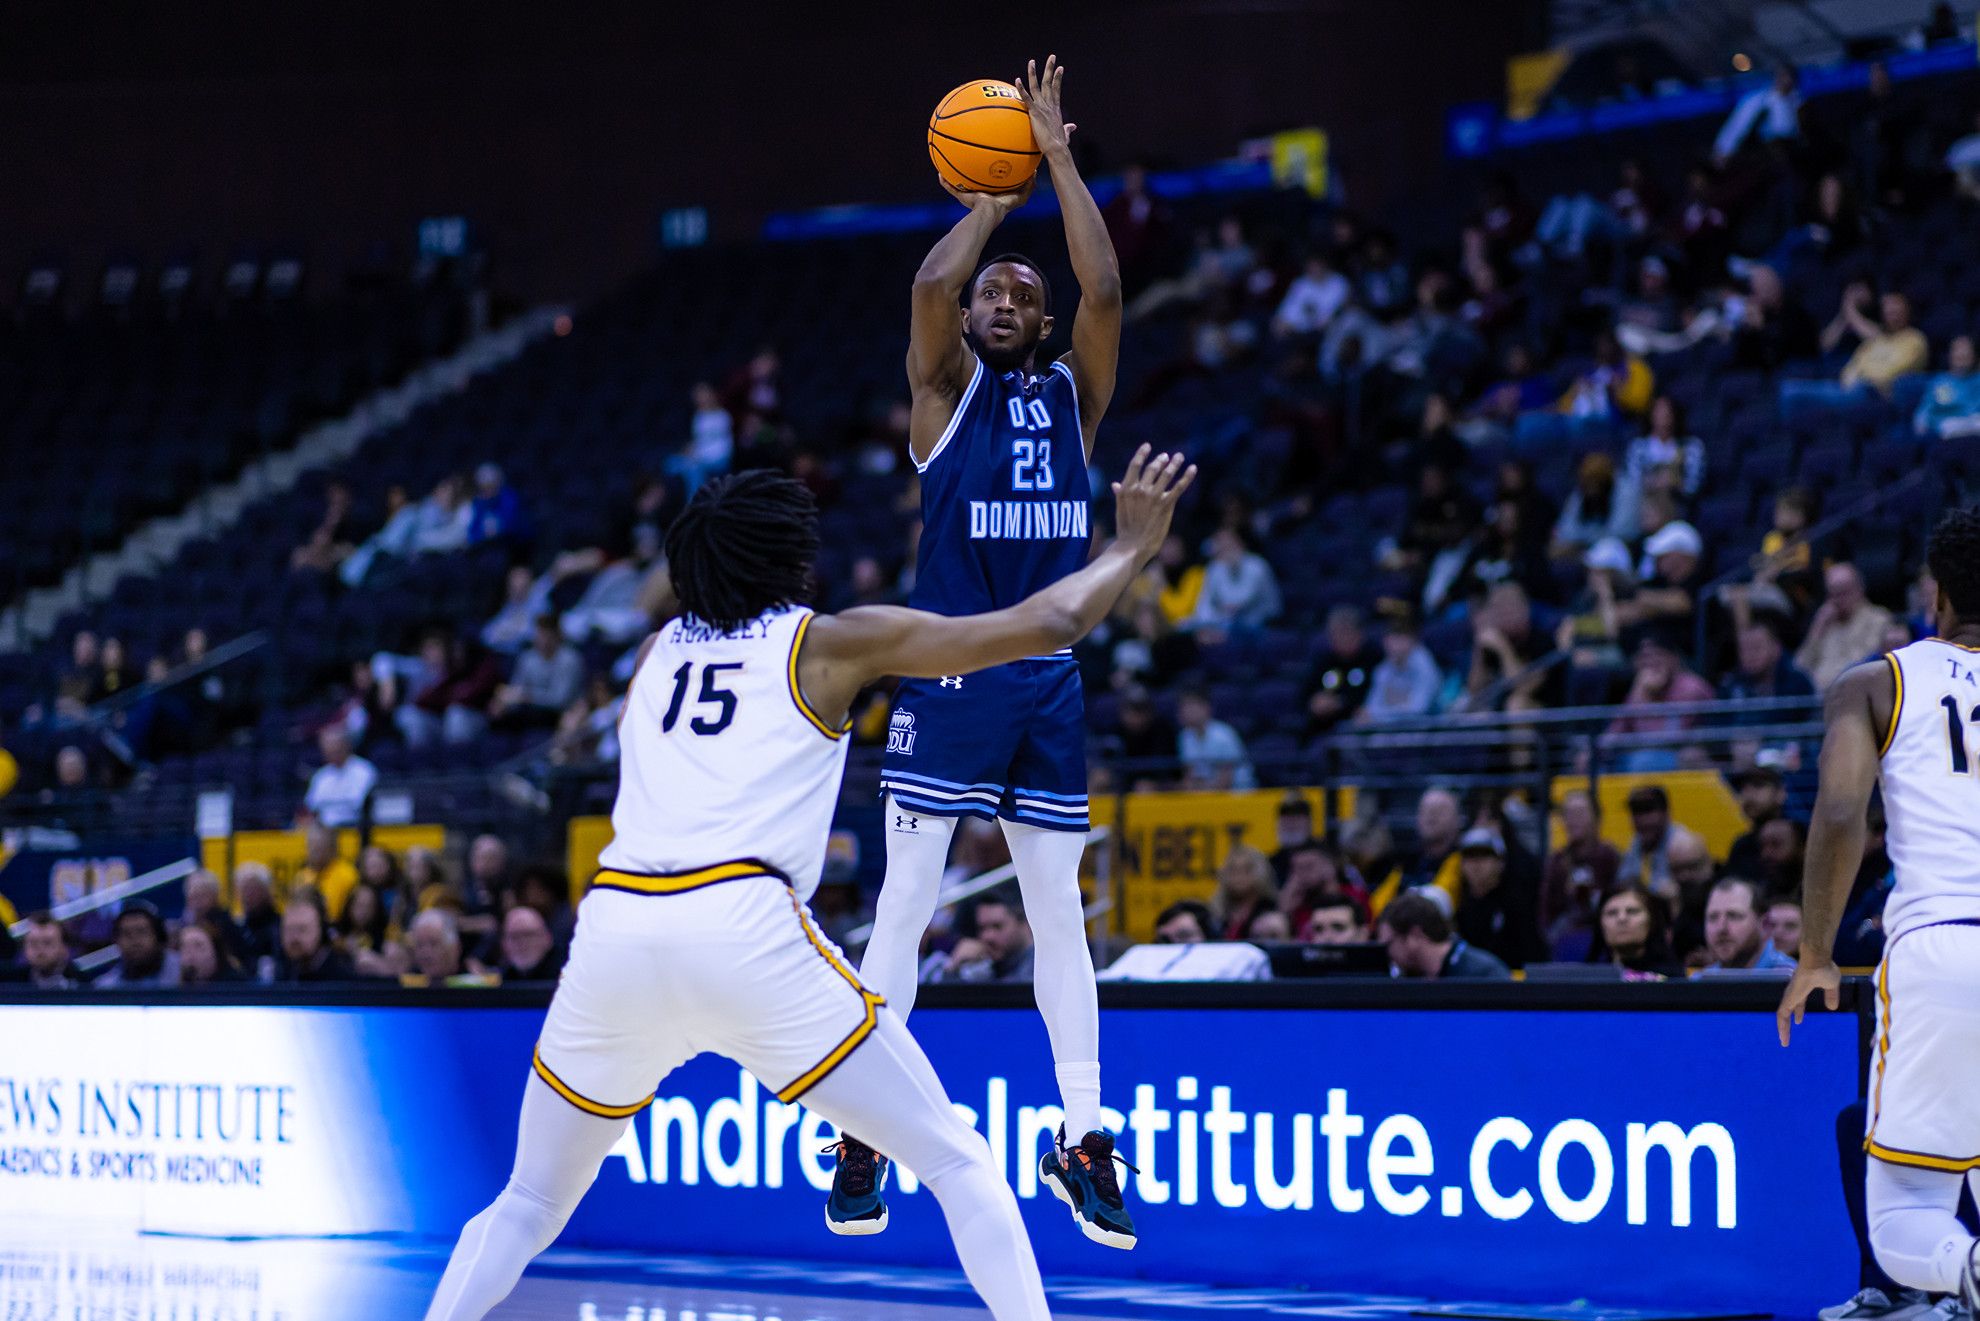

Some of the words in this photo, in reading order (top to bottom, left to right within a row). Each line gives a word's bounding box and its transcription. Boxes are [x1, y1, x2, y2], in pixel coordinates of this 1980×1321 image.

[1008, 395, 1053, 431] OD
[1012, 438, 1055, 491] 23
[970, 500, 1088, 539] DOMINION
[662, 660, 744, 736] 15
[887, 730, 917, 755] DU
[78, 1080, 295, 1143] INSTITUTE
[70, 1150, 80, 1177] &
[90, 1150, 157, 1182] SPORTS
[167, 1155, 262, 1188] MEDICINE
